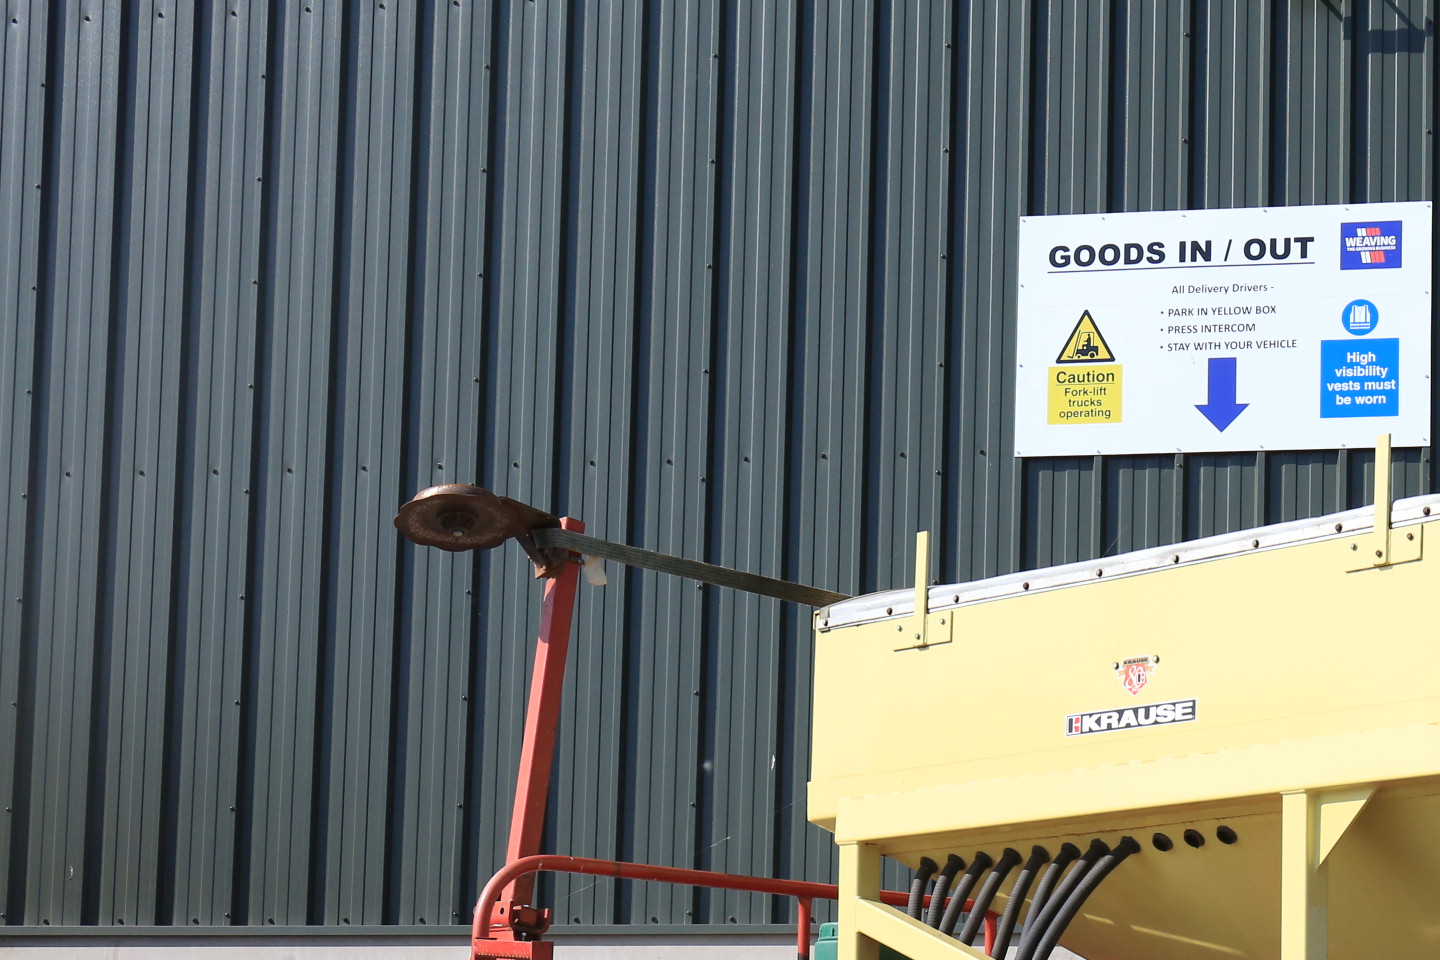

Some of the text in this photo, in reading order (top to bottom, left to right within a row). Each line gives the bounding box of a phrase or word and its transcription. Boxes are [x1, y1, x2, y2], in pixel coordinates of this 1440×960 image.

[1345, 235, 1396, 247] WEAVING
[1048, 236, 1315, 268] GOODS IN / OUT
[1171, 284, 1185, 294] All
[1187, 284, 1229, 295] Delivery
[1232, 283, 1268, 293] Drivers
[1168, 305, 1277, 317] PARK IN YELLOW BOX
[1167, 323, 1256, 334] PRESS INTERCOM
[1167, 339, 1297, 352] STAY WITH YOUR VEHICLE
[1346, 351, 1376, 366] High
[1055, 370, 1115, 384] Caution
[1334, 365, 1389, 379] visibility
[1064, 386, 1107, 397] Fork-lift
[1326, 379, 1396, 392] vests must
[1068, 398, 1103, 408] trucks
[1335, 394, 1387, 406] be worn
[1059, 408, 1111, 420] operating
[1081, 701, 1194, 733] KRAUSE
